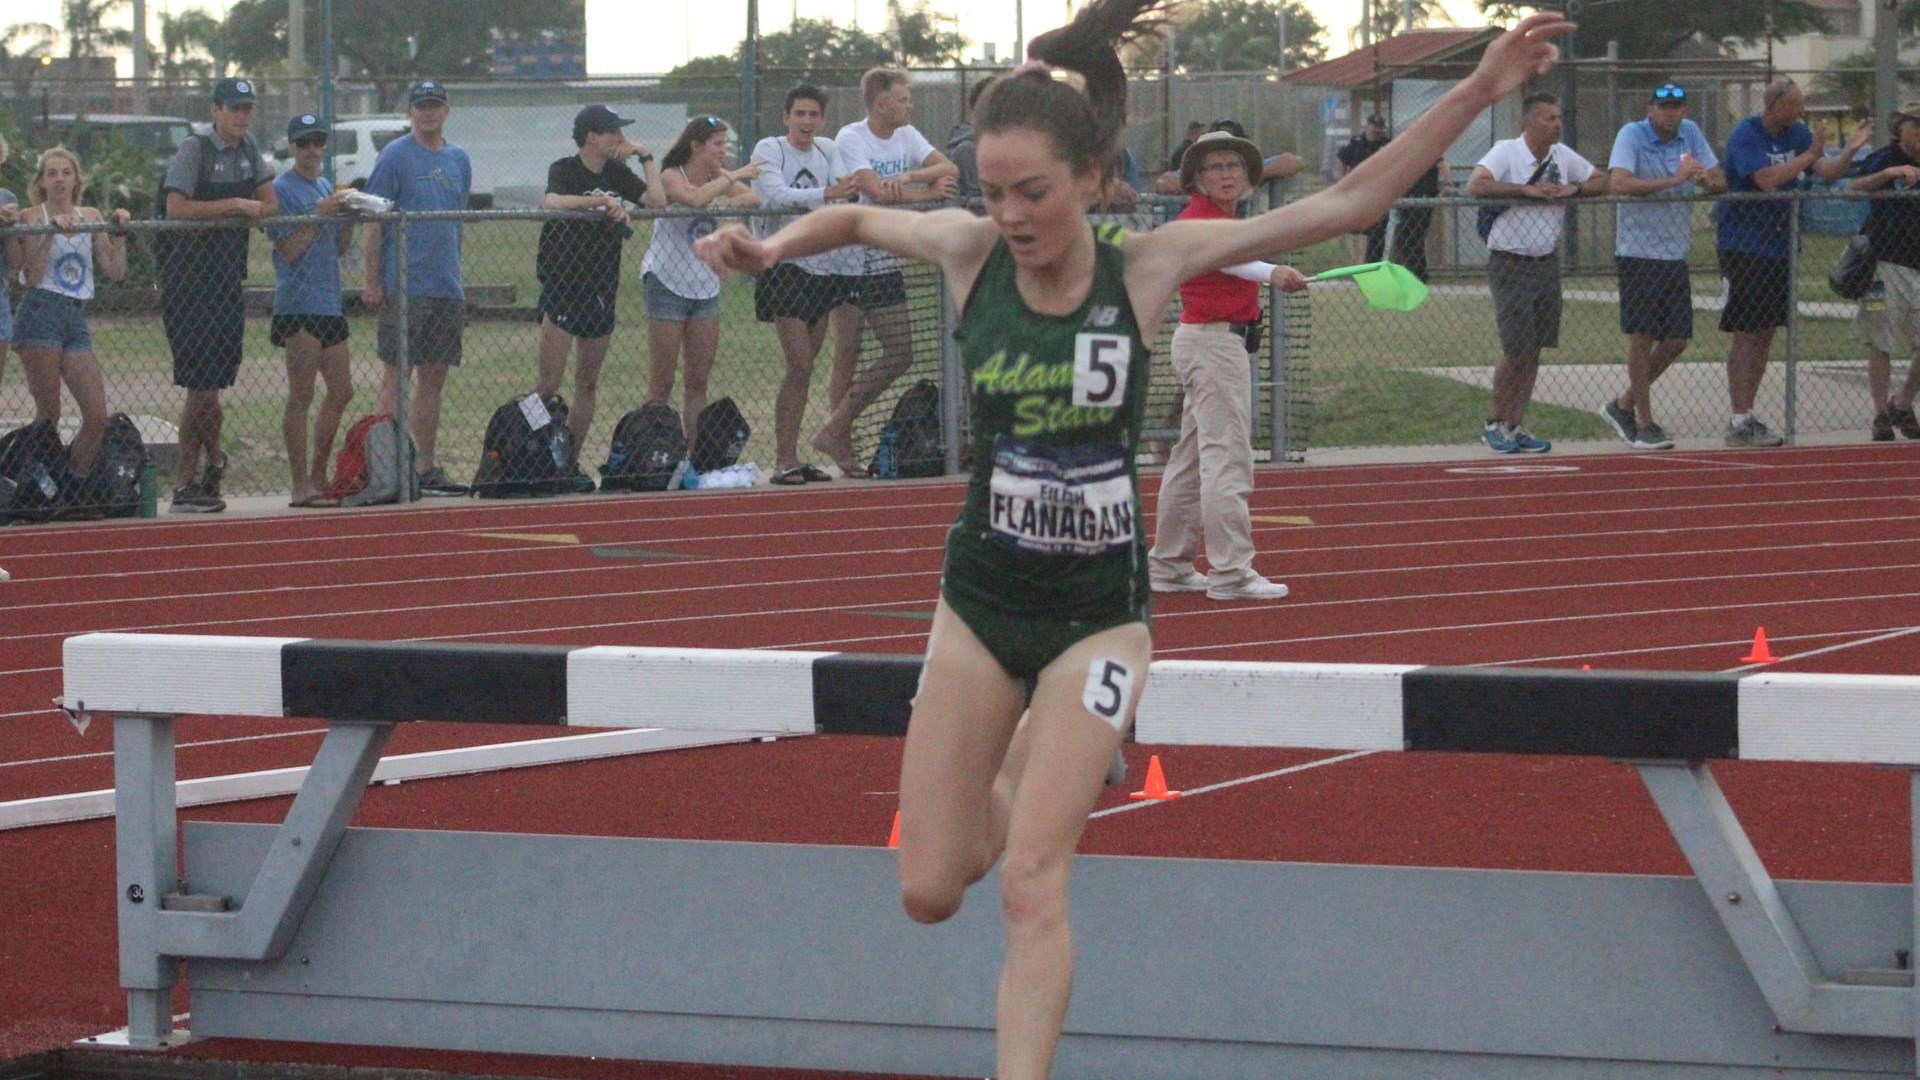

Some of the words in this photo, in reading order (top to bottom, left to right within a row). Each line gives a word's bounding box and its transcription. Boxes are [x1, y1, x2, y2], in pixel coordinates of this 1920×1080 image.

[972, 350, 1074, 395] Adam
[1086, 340, 1118, 403] 5
[993, 492, 1132, 541] FLANAGAN
[1094, 660, 1127, 718] 5
